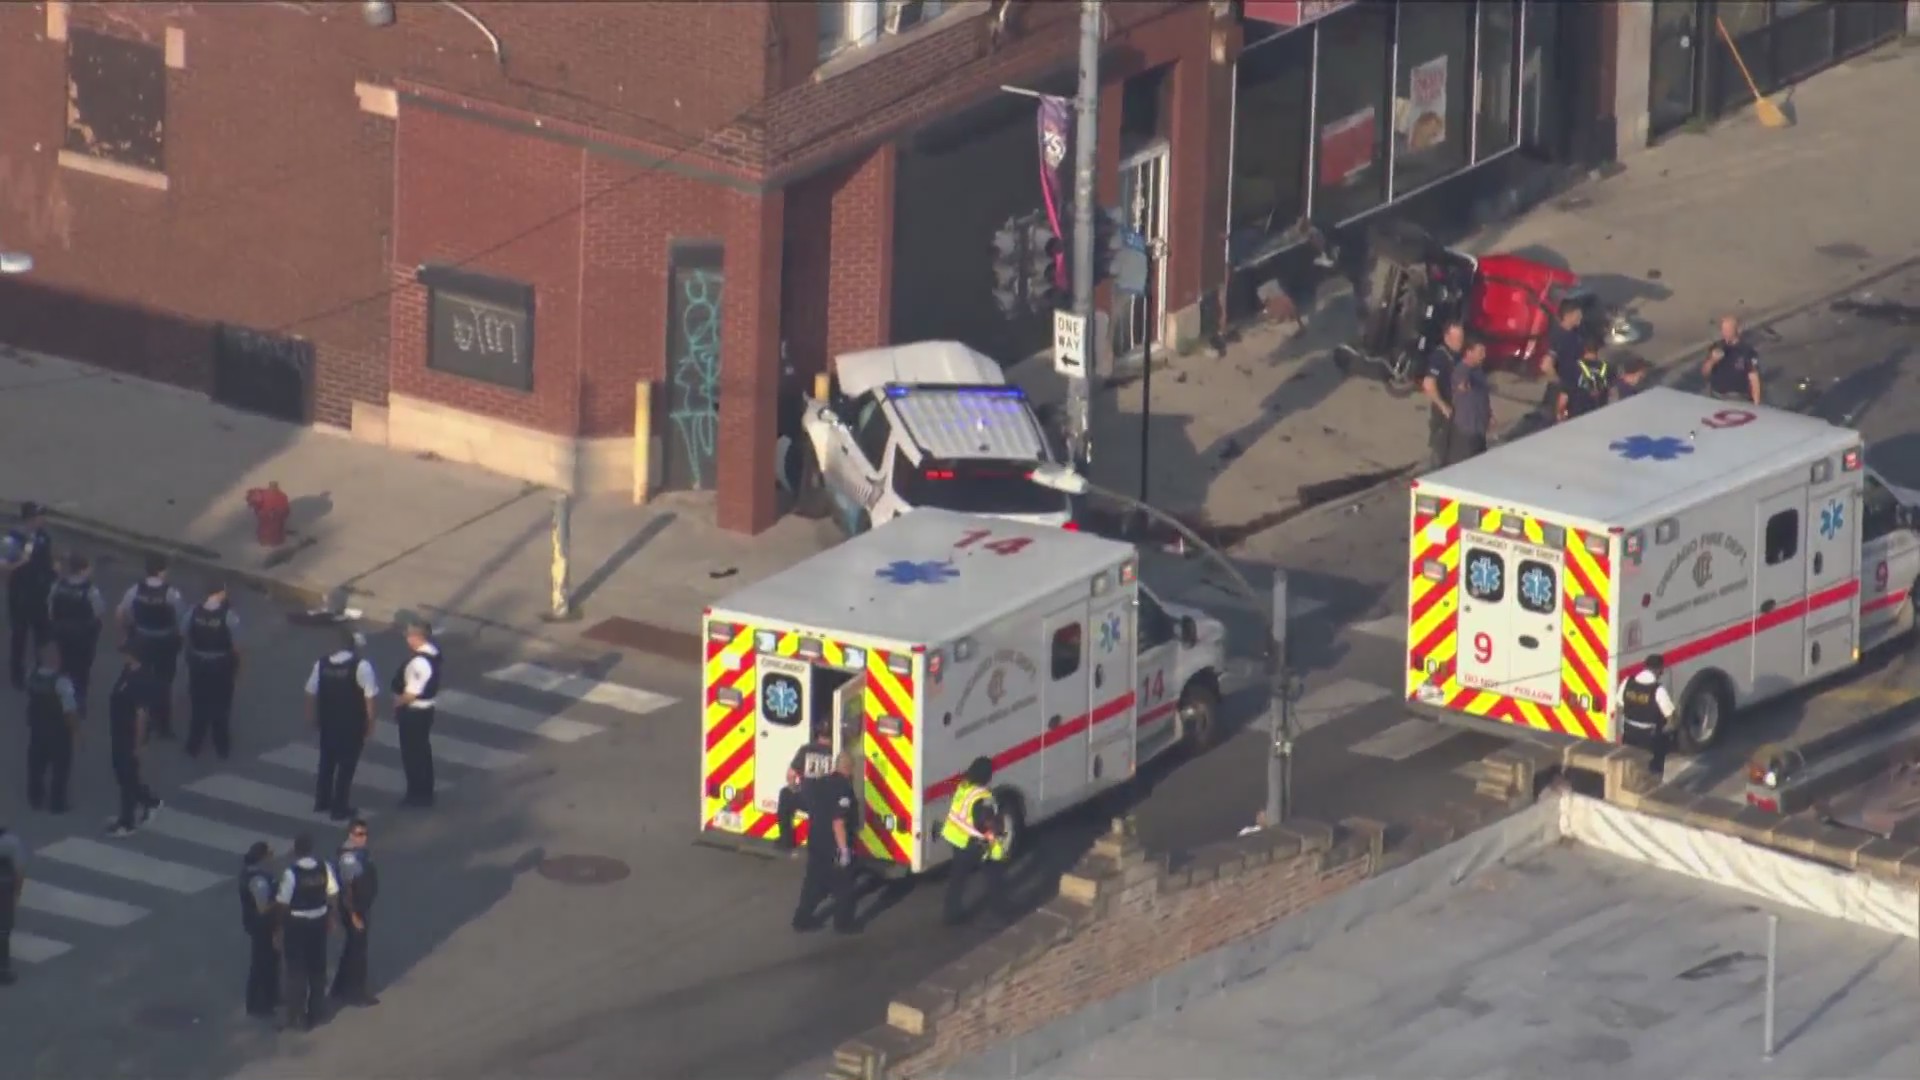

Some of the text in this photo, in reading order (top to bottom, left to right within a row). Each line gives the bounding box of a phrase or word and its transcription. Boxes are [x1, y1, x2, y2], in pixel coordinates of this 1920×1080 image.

[1058, 316, 1080, 337] ONE
[1058, 335, 1081, 352] WAY
[953, 529, 1034, 557] 14
[1876, 560, 1889, 592] 9
[1473, 631, 1493, 664] 9
[1142, 669, 1165, 705] 14
